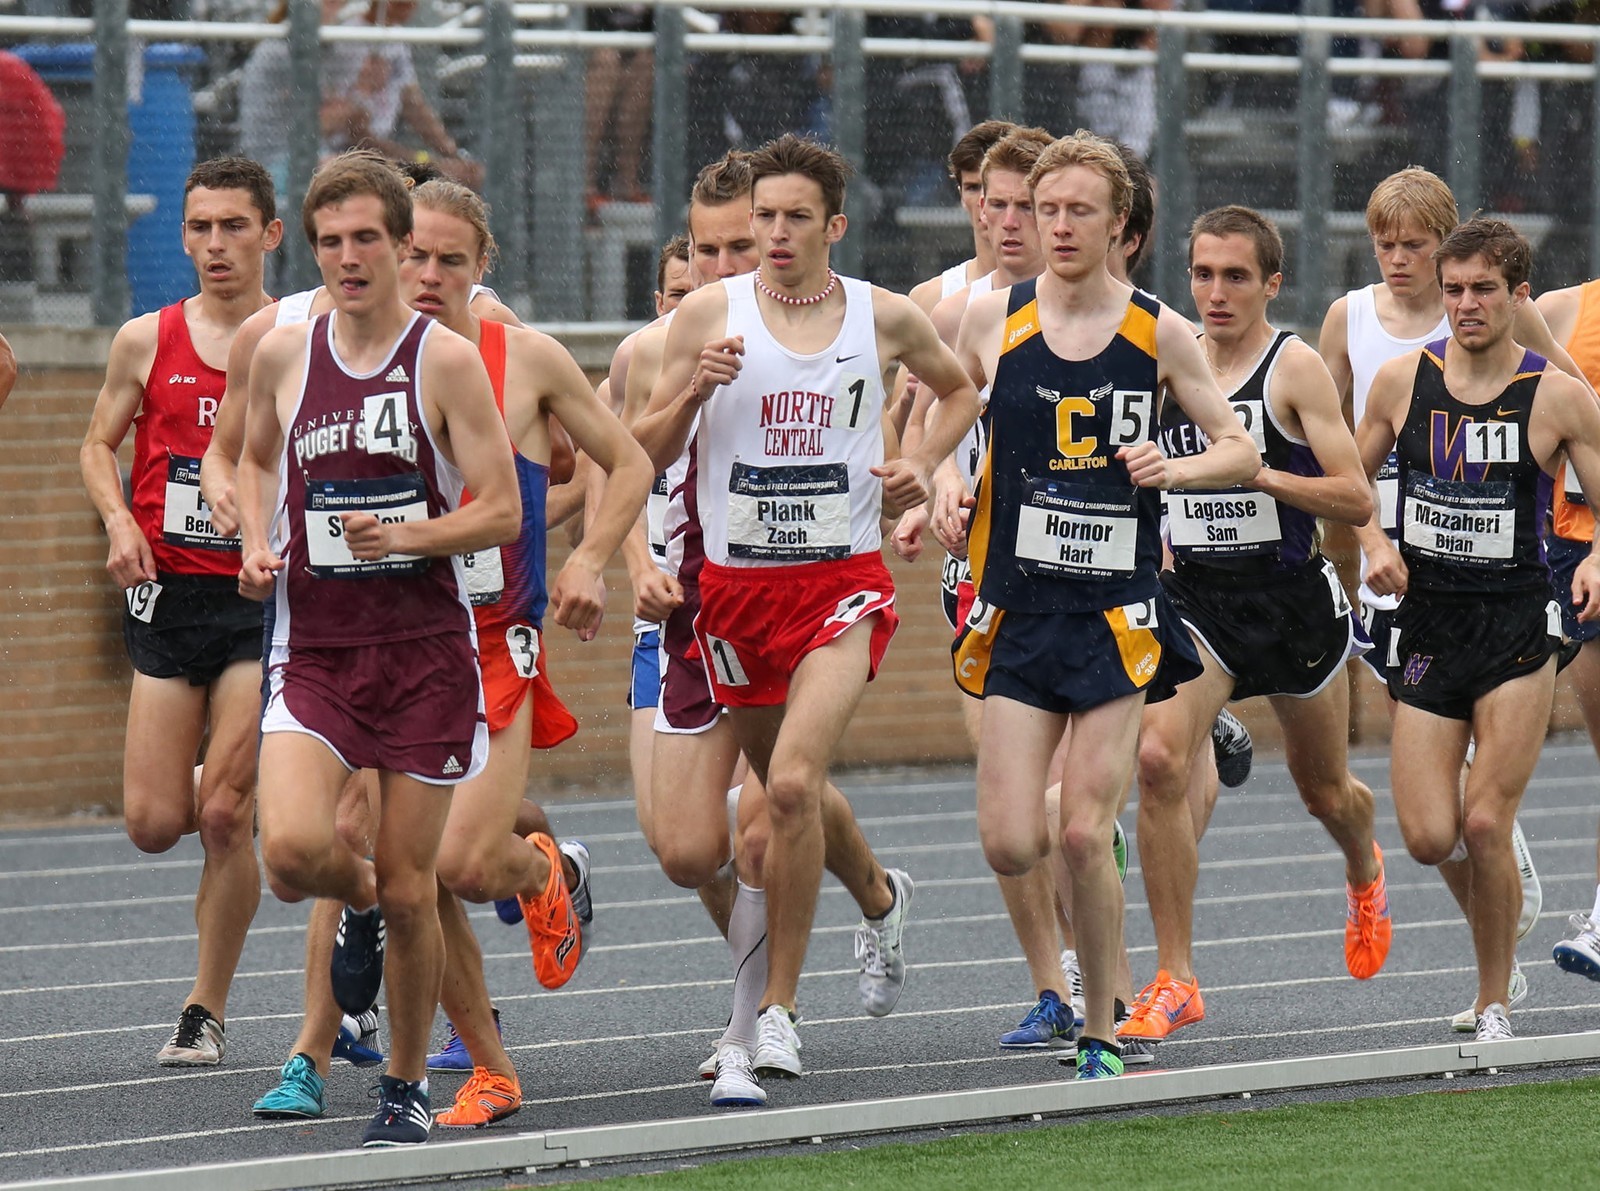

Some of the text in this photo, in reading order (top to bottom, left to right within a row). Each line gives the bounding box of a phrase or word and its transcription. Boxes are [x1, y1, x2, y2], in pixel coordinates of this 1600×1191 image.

[760, 391, 834, 428] NORTH
[848, 379, 865, 428] 1
[374, 397, 402, 448] 4
[1056, 397, 1097, 458] C
[1119, 395, 1143, 443] 5
[294, 422, 351, 467] PUGET
[765, 428, 824, 456] CENTRAL
[1476, 425, 1507, 460] 11
[1049, 456, 1107, 470] CARLETON
[350, 496, 365, 504] FIELD
[366, 489, 417, 503] CHAMPIONSHIPS
[789, 481, 838, 490] CHAMPIONSHIPS
[1425, 490, 1439, 499] TRACK
[1444, 495, 1459, 503] FIELD
[757, 500, 816, 521] Plank
[1046, 496, 1064, 505] TRACK
[1068, 500, 1084, 509] FIELD
[1085, 503, 1131, 512] CHAMPIONSHIPS
[1184, 498, 1257, 521] Lagasse
[1046, 514, 1113, 542] Hornor
[1415, 503, 1500, 534] Mazaheri
[768, 527, 807, 544] Zach
[1207, 525, 1238, 541] Sam
[1436, 533, 1473, 553] Bijan
[1060, 544, 1093, 564] Hart
[514, 627, 534, 675] 3
[713, 639, 735, 683] 1
[960, 657, 977, 678] C
